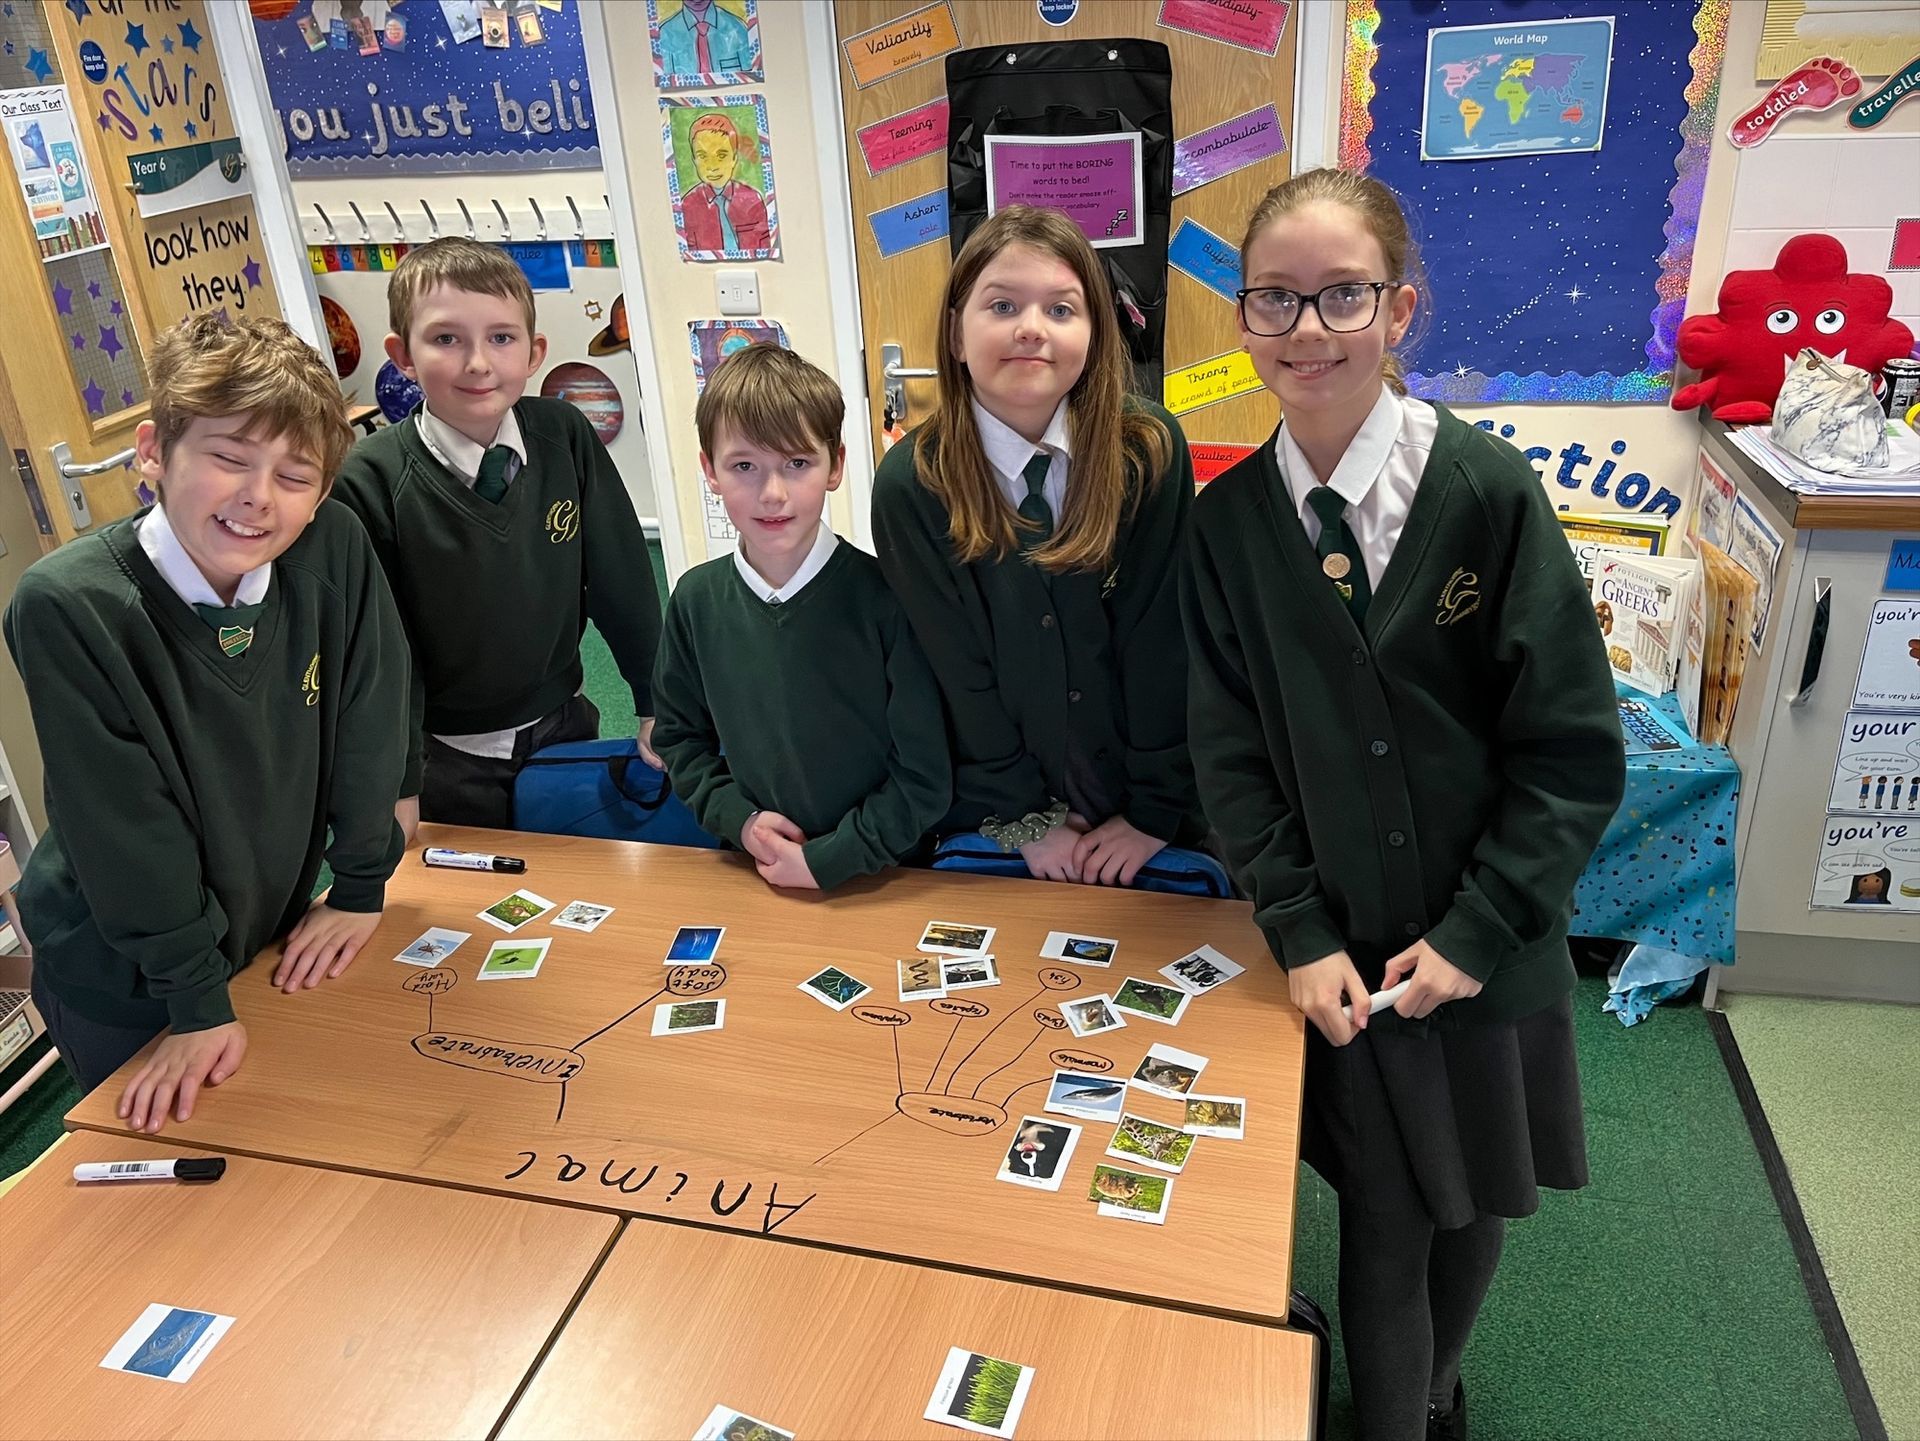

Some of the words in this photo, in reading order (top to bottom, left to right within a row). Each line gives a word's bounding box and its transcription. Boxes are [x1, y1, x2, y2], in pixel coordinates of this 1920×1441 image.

[1494, 34, 1523, 46] World
[1526, 34, 1548, 46] Map
[2, 104, 17, 115] Our
[20, 101, 41, 113] Class
[42, 99, 62, 110] Text
[1746, 81, 1810, 131] toddled
[367, 82, 472, 154] just
[134, 161, 158, 177] Year
[159, 159, 166, 172] 6
[1009, 160, 1029, 170] Time
[1031, 160, 1040, 169] to
[1042, 161, 1056, 171] put
[1059, 160, 1074, 169] the
[1075, 158, 1114, 169] BORING
[1033, 176, 1057, 185] words
[1060, 176, 1069, 185] to
[1071, 175, 1090, 185] bed!
[1009, 191, 1025, 199] Don't
[1043, 191, 1054, 199] the
[145, 221, 200, 268] look
[199, 215, 250, 254] how
[313, 250, 322, 265] 4
[326, 248, 336, 264] 5
[341, 248, 350, 263] 6
[354, 248, 362, 263] 7
[370, 247, 379, 262] 8
[383, 247, 393, 262] 9
[183, 272, 246, 310] they
[1181, 389, 1212, 405] crowd
[1217, 381, 1227, 393] of
[1474, 420, 1681, 520] ction
[1583, 532, 1605, 541] AND
[1609, 534, 1640, 546] POOR
[1602, 579, 1660, 618] GREEKS
[1621, 579, 1655, 599] ANCIENT
[1858, 691, 1886, 700] You're
[1888, 692, 1907, 702] very
[1850, 721, 1916, 743] your
[1827, 821, 1908, 847] you're
